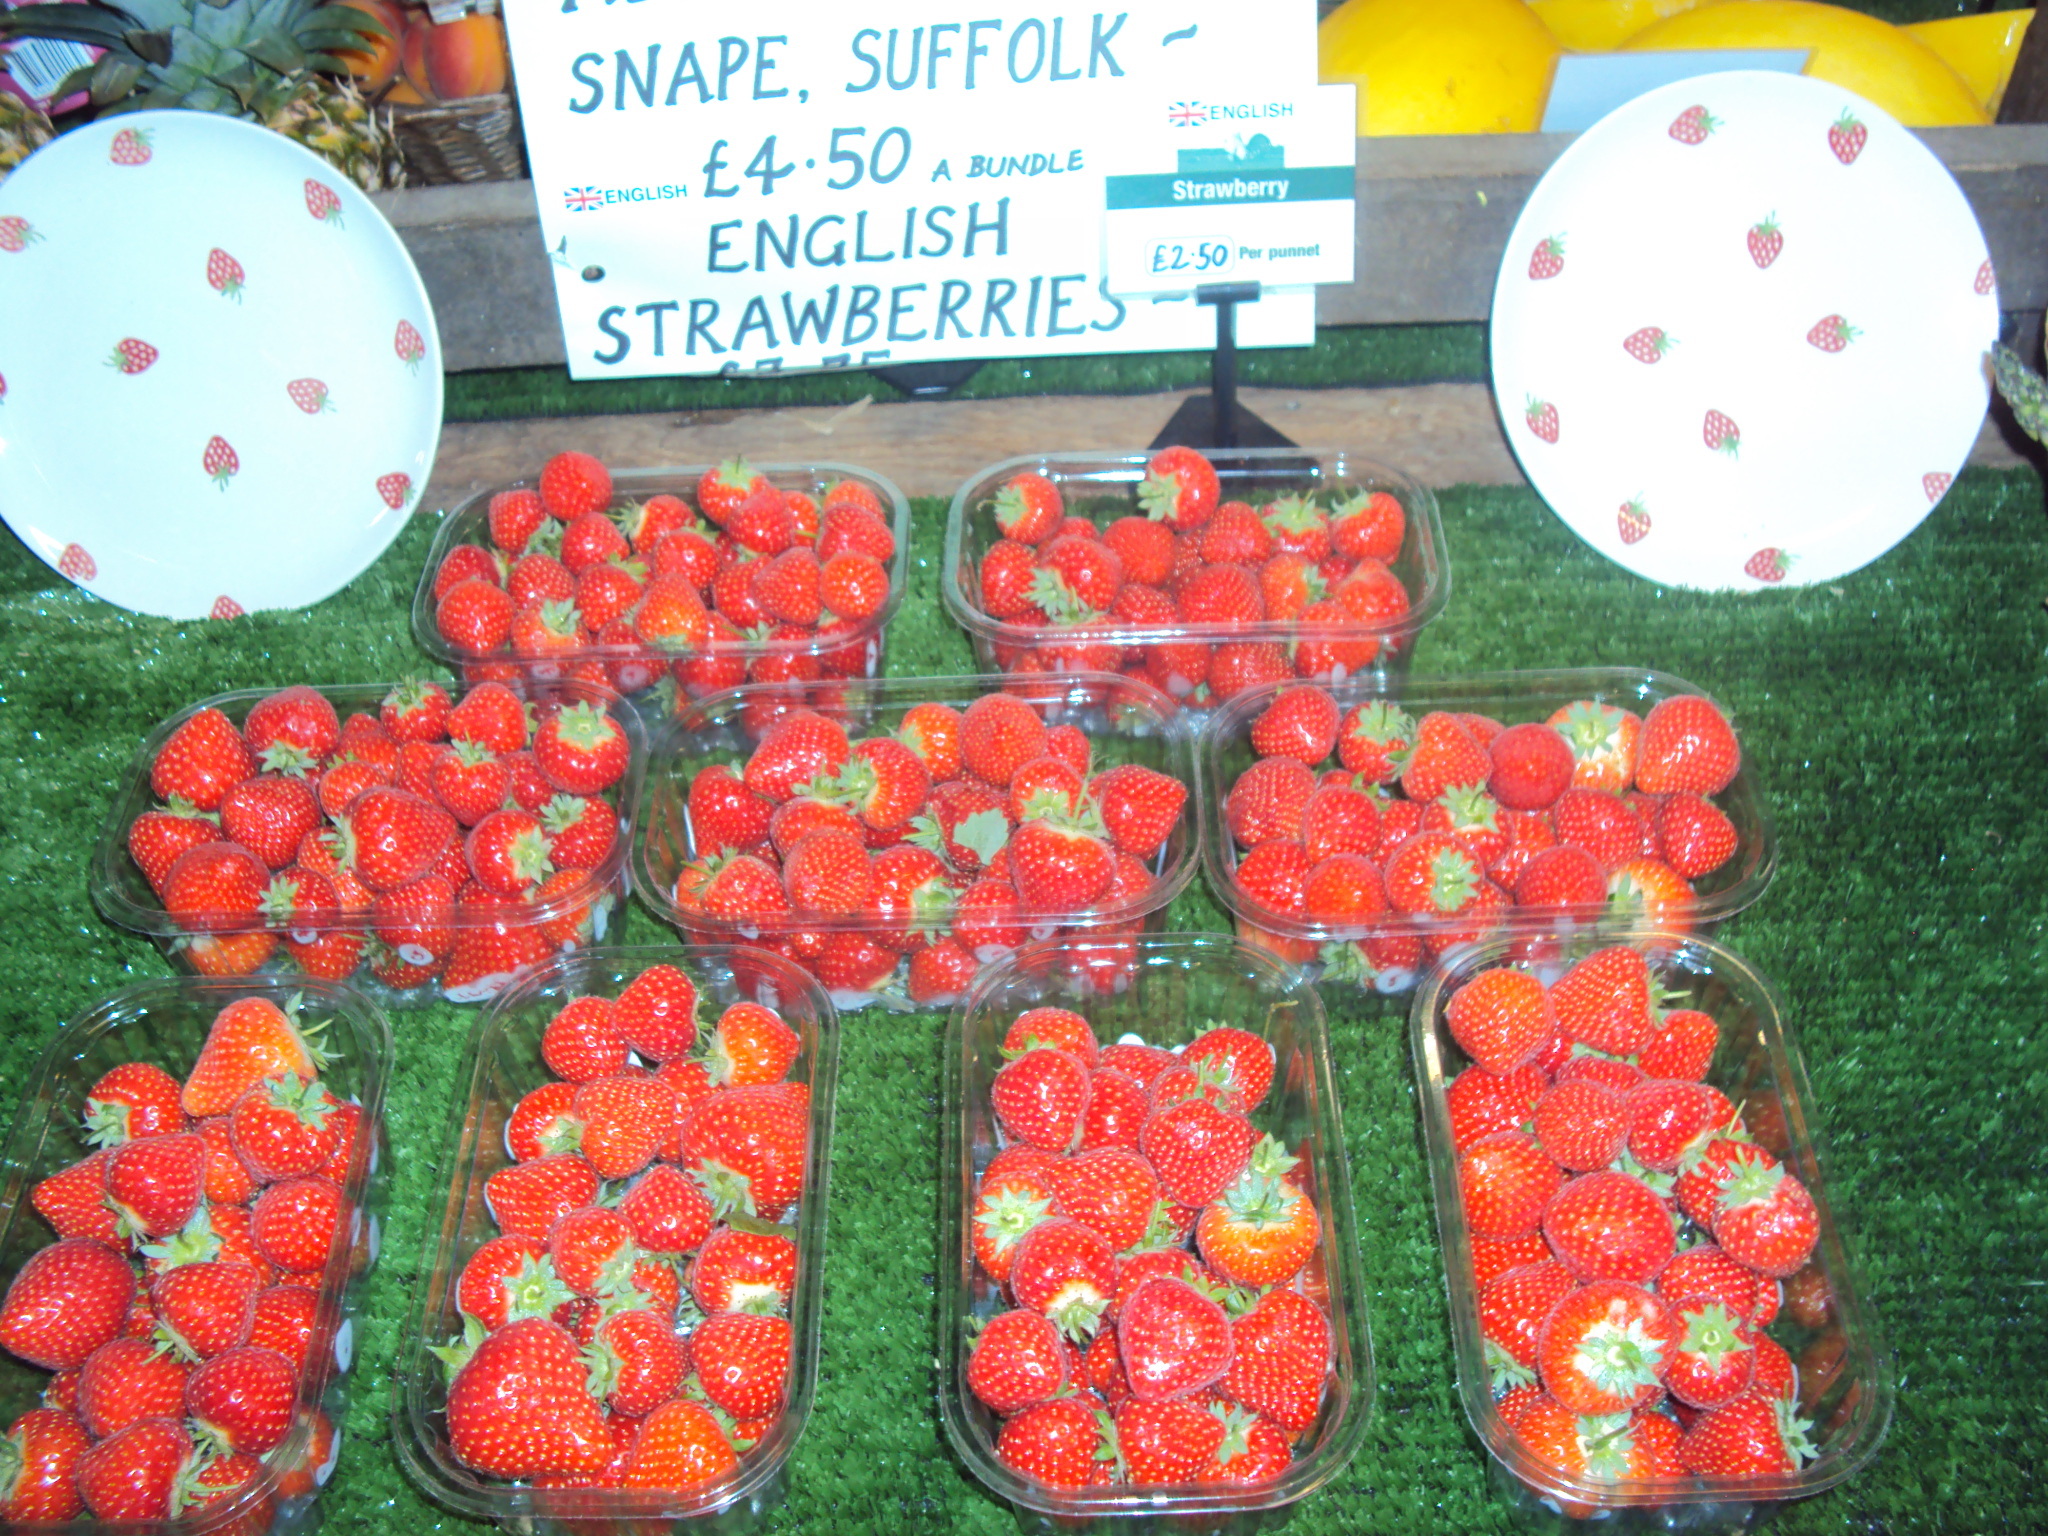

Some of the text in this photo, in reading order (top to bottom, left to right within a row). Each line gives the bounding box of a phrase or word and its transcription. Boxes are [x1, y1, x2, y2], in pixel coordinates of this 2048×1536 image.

[568, 34, 809, 115] SNAPE,
[845, 12, 1128, 94] SUFFOLK
[1209, 102, 1293, 120] ENGLISH
[931, 159, 952, 183] A
[966, 149, 1084, 179] BUNDLE
[605, 184, 689, 204] ENGLISH
[1172, 178, 1290, 200] Strawberry
[707, 196, 1010, 274] ENGLISH
[1239, 246, 1264, 260] Per
[1268, 243, 1321, 260] punnet
[593, 273, 1126, 366] STRAWBERRIES
